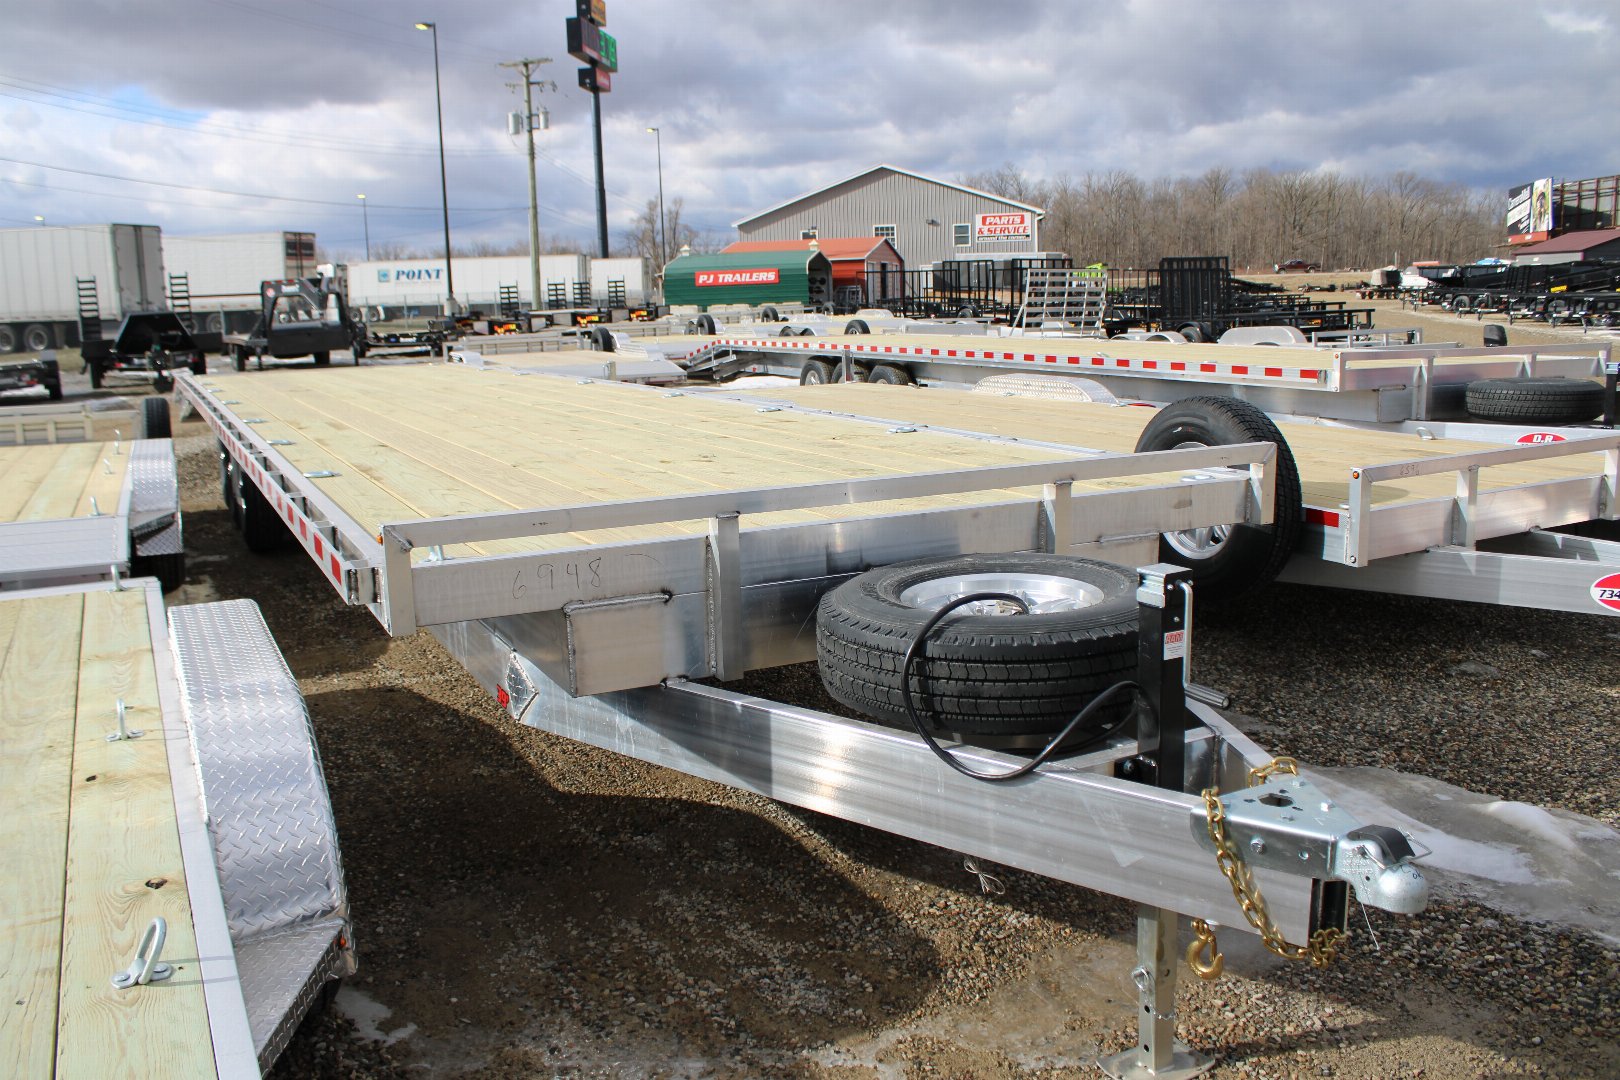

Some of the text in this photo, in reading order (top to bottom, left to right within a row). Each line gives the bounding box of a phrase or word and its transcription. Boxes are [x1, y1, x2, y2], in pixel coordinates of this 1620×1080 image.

[985, 216, 1021, 225] PARTS
[977, 226, 1029, 235] & SERVICE
[395, 268, 443, 281] POINT
[698, 271, 776, 284] PJ TRAILERS
[511, 556, 602, 600] 6948
